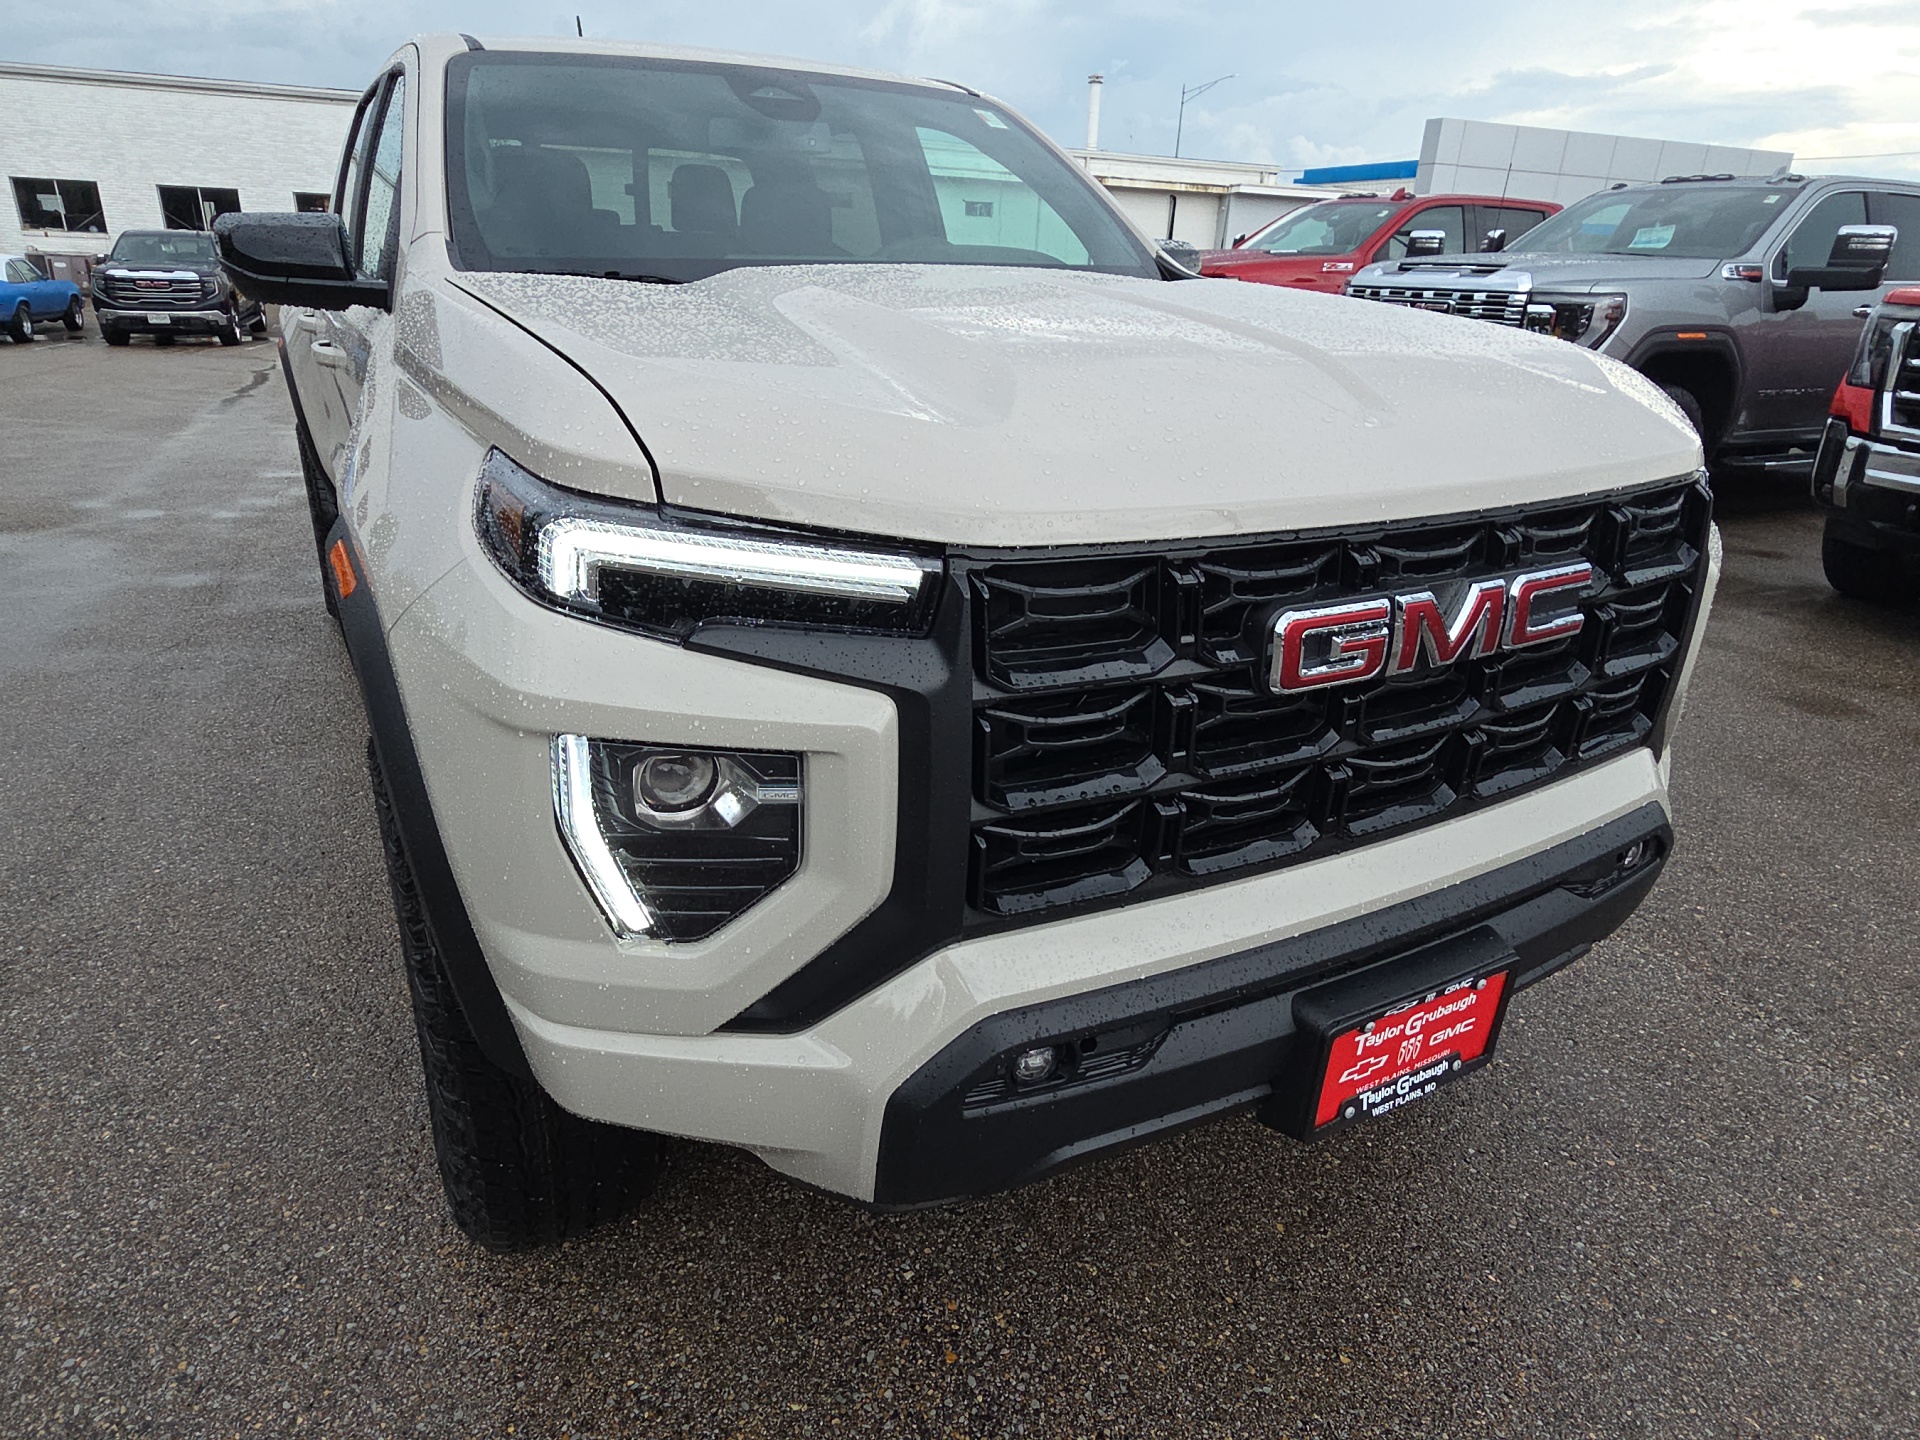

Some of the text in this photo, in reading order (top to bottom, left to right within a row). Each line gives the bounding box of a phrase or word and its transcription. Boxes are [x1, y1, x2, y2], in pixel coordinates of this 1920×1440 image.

[1269, 562, 1593, 695] GMC
[1444, 977, 1474, 995] GMC
[1354, 993, 1477, 1056] Taylor Grubaugh
[1429, 1017, 1476, 1046] GMC
[1355, 1079, 1380, 1094] WEST
[1359, 1059, 1449, 1111] Taylor Grubaugh
[1371, 1100, 1395, 1117] WEST
[1424, 1082, 1437, 1093] MO
